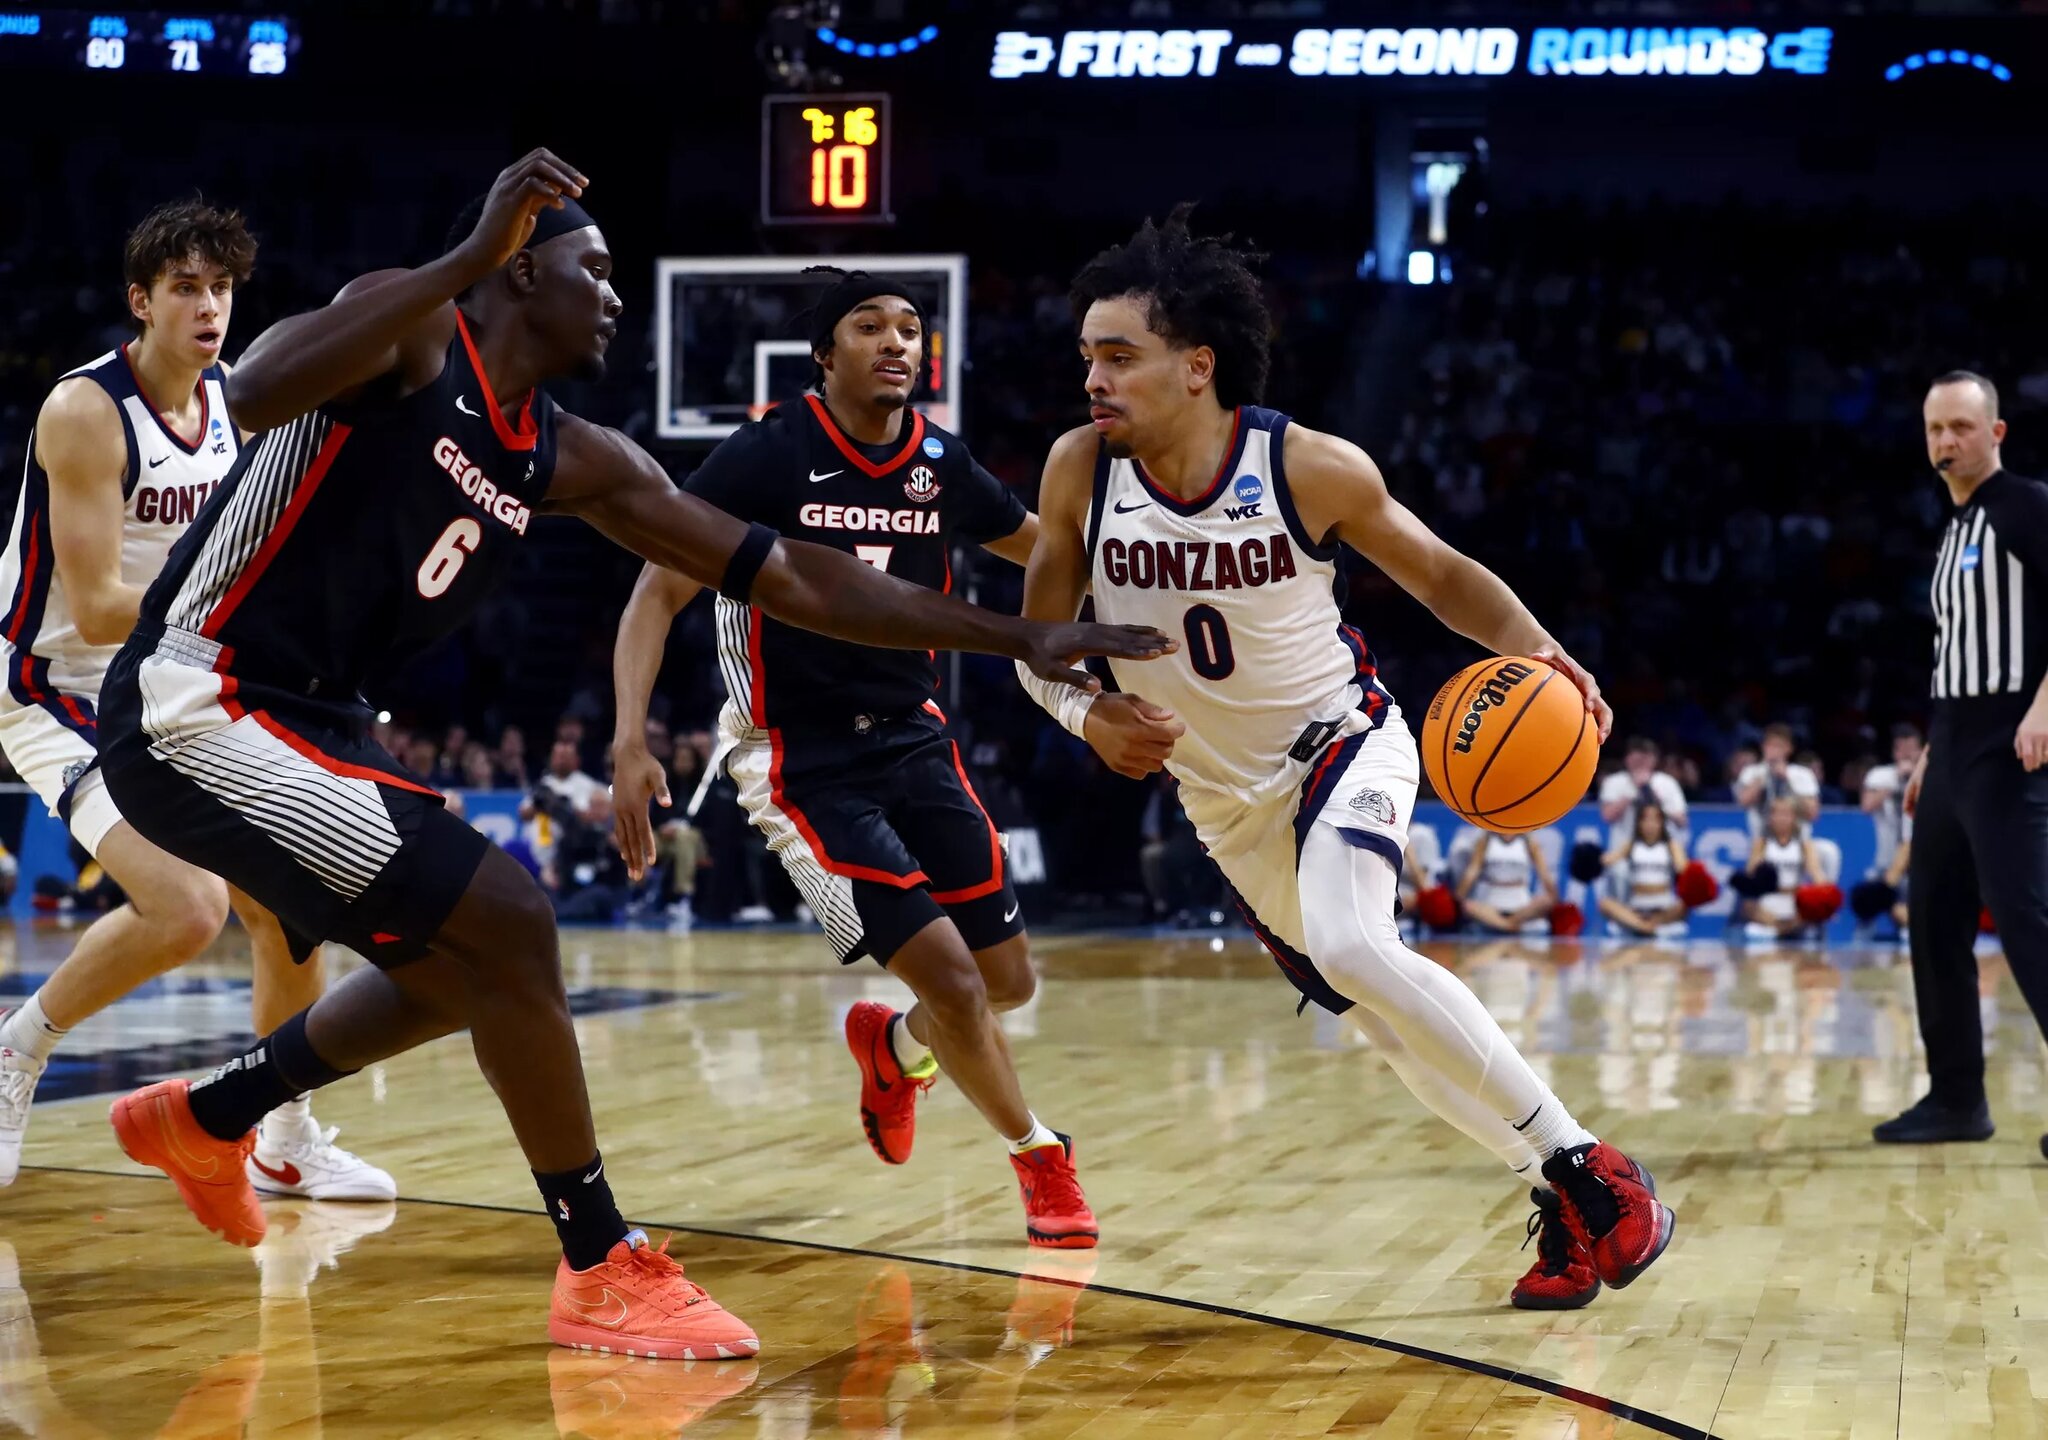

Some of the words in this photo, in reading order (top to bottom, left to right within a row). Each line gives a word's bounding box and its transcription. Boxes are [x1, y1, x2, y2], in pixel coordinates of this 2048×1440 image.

[168, 40, 200, 71] 71
[1058, 30, 1232, 77] FIRST
[1289, 28, 1519, 76] SECOND
[1528, 27, 1768, 76] ROUNDS
[802, 107, 878, 146] 7:16
[811, 145, 868, 208] 10
[911, 466, 934, 493] SEC
[1239, 486, 1262, 498] NCAA
[799, 502, 941, 534] GEORGIA
[1223, 503, 1263, 522] WCC
[417, 516, 482, 599] 6
[1102, 533, 1297, 591] GONZAGA
[1183, 602, 1236, 681] 0
[1453, 661, 1538, 754] Wilson
